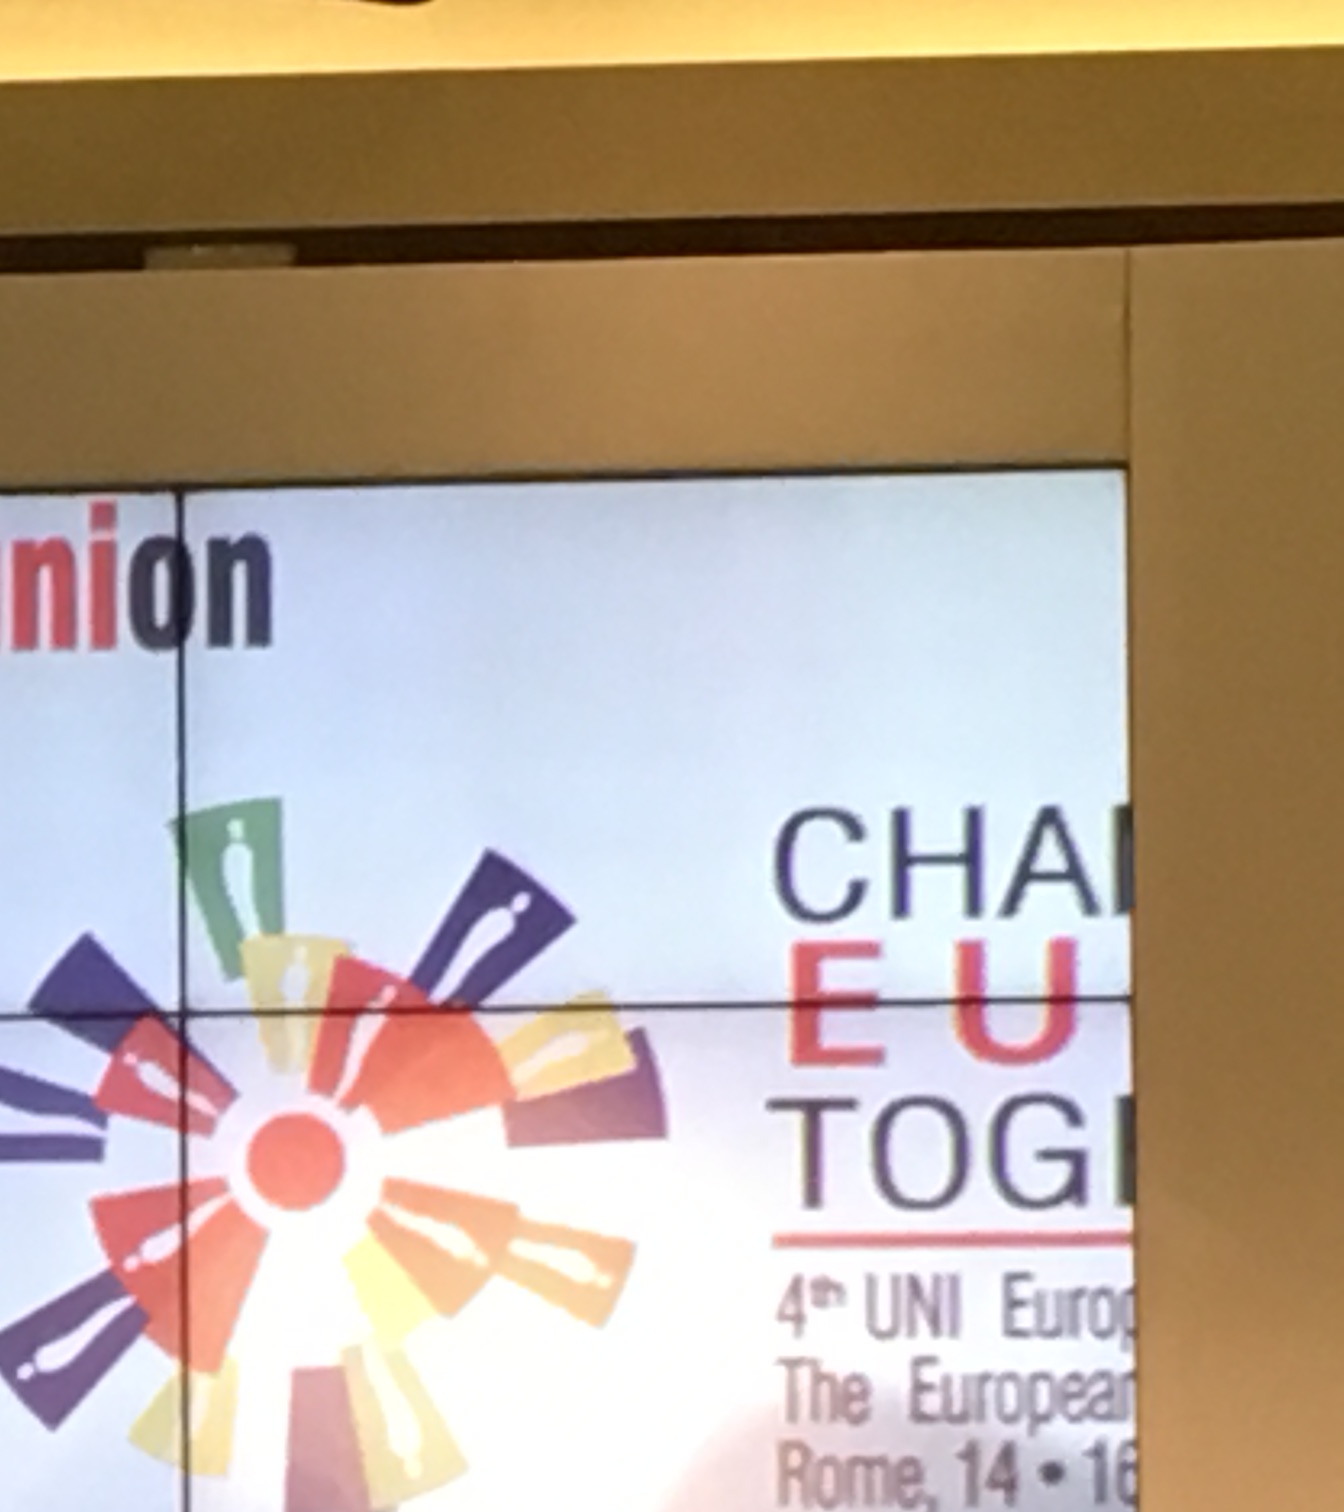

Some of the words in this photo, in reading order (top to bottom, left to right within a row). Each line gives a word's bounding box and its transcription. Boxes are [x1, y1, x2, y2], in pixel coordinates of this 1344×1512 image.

[864, 1272, 961, 1342] UNI
[776, 1356, 872, 1427] The
[955, 1439, 1019, 1508] 14
